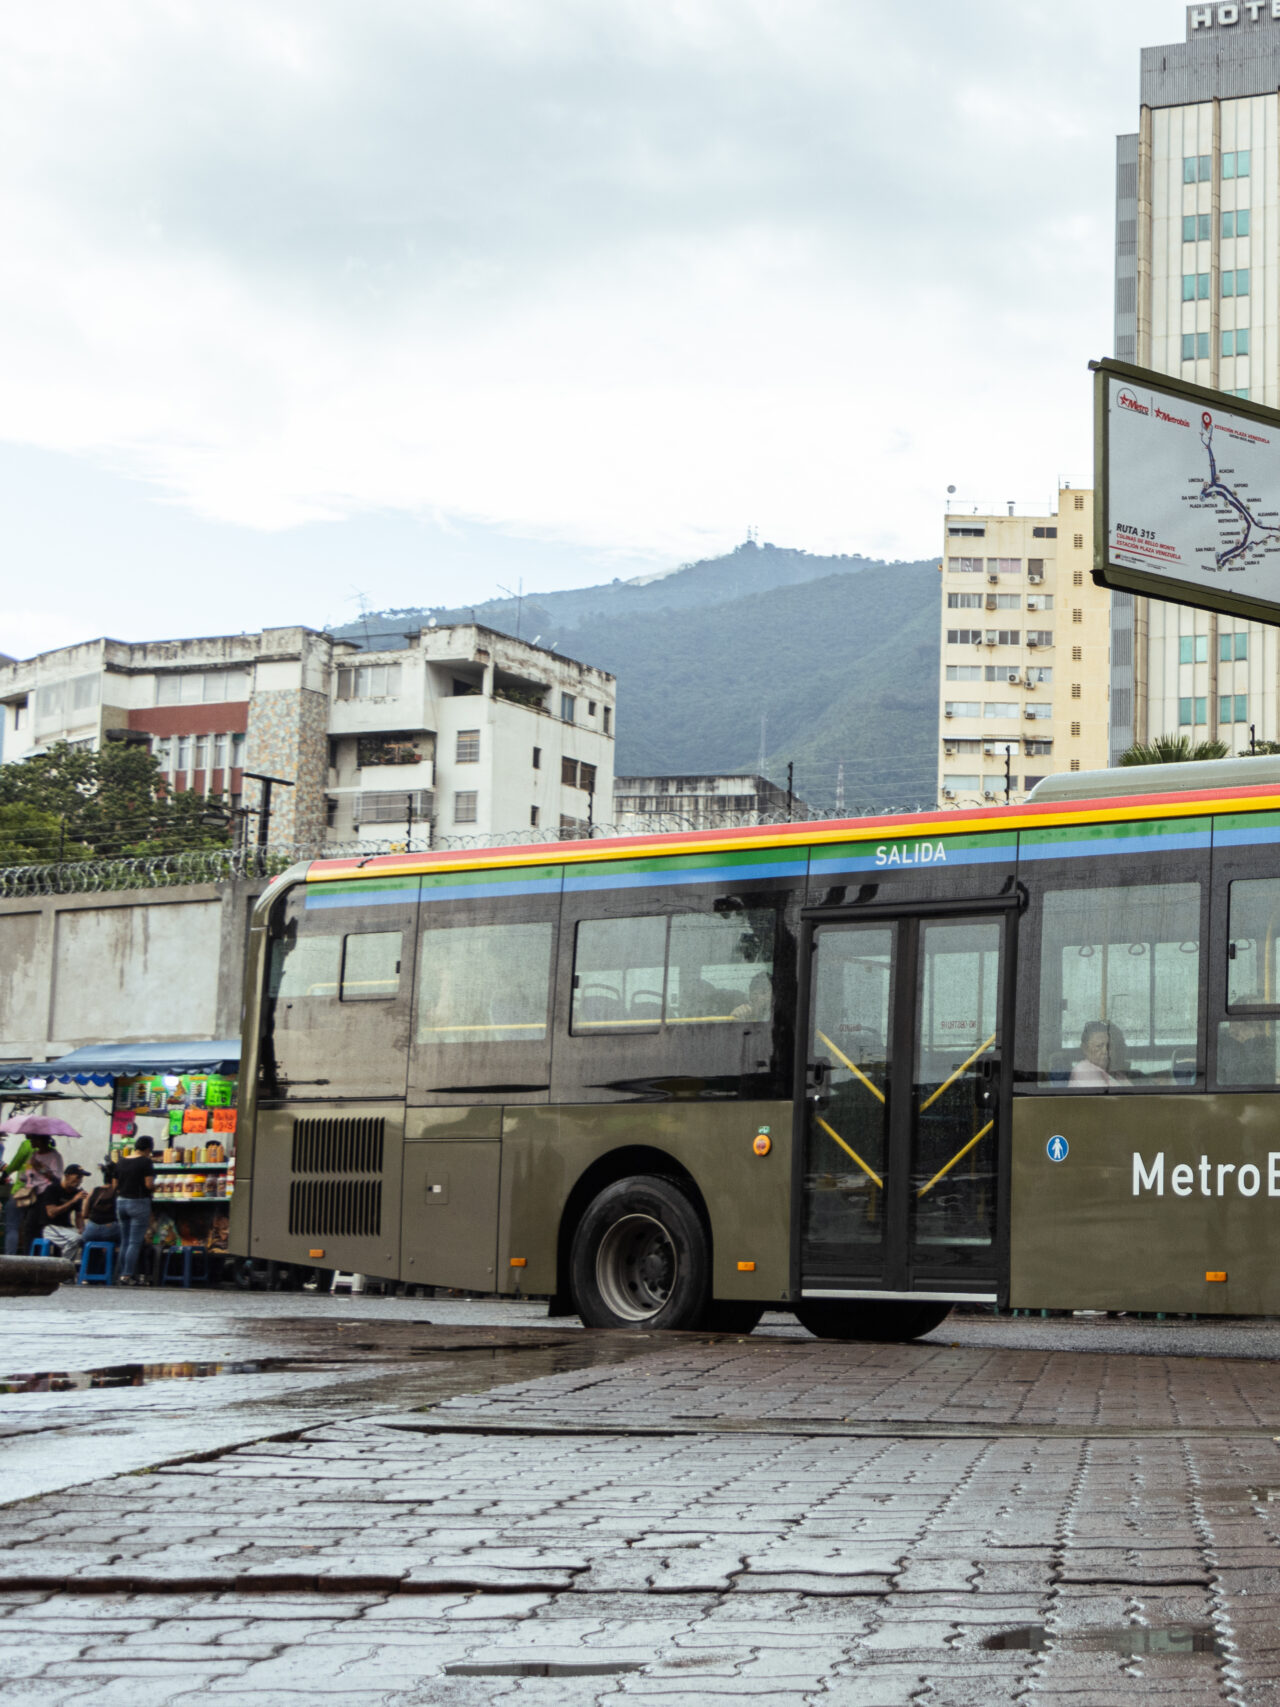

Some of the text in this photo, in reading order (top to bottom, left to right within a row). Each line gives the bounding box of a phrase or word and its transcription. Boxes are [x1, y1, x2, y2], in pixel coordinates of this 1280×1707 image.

[1127, 399, 1149, 413] Metro
[1116, 523, 1156, 540] RUTA 315
[1140, 545, 1154, 554] PLAZA
[875, 842, 947, 865] SALIDA
